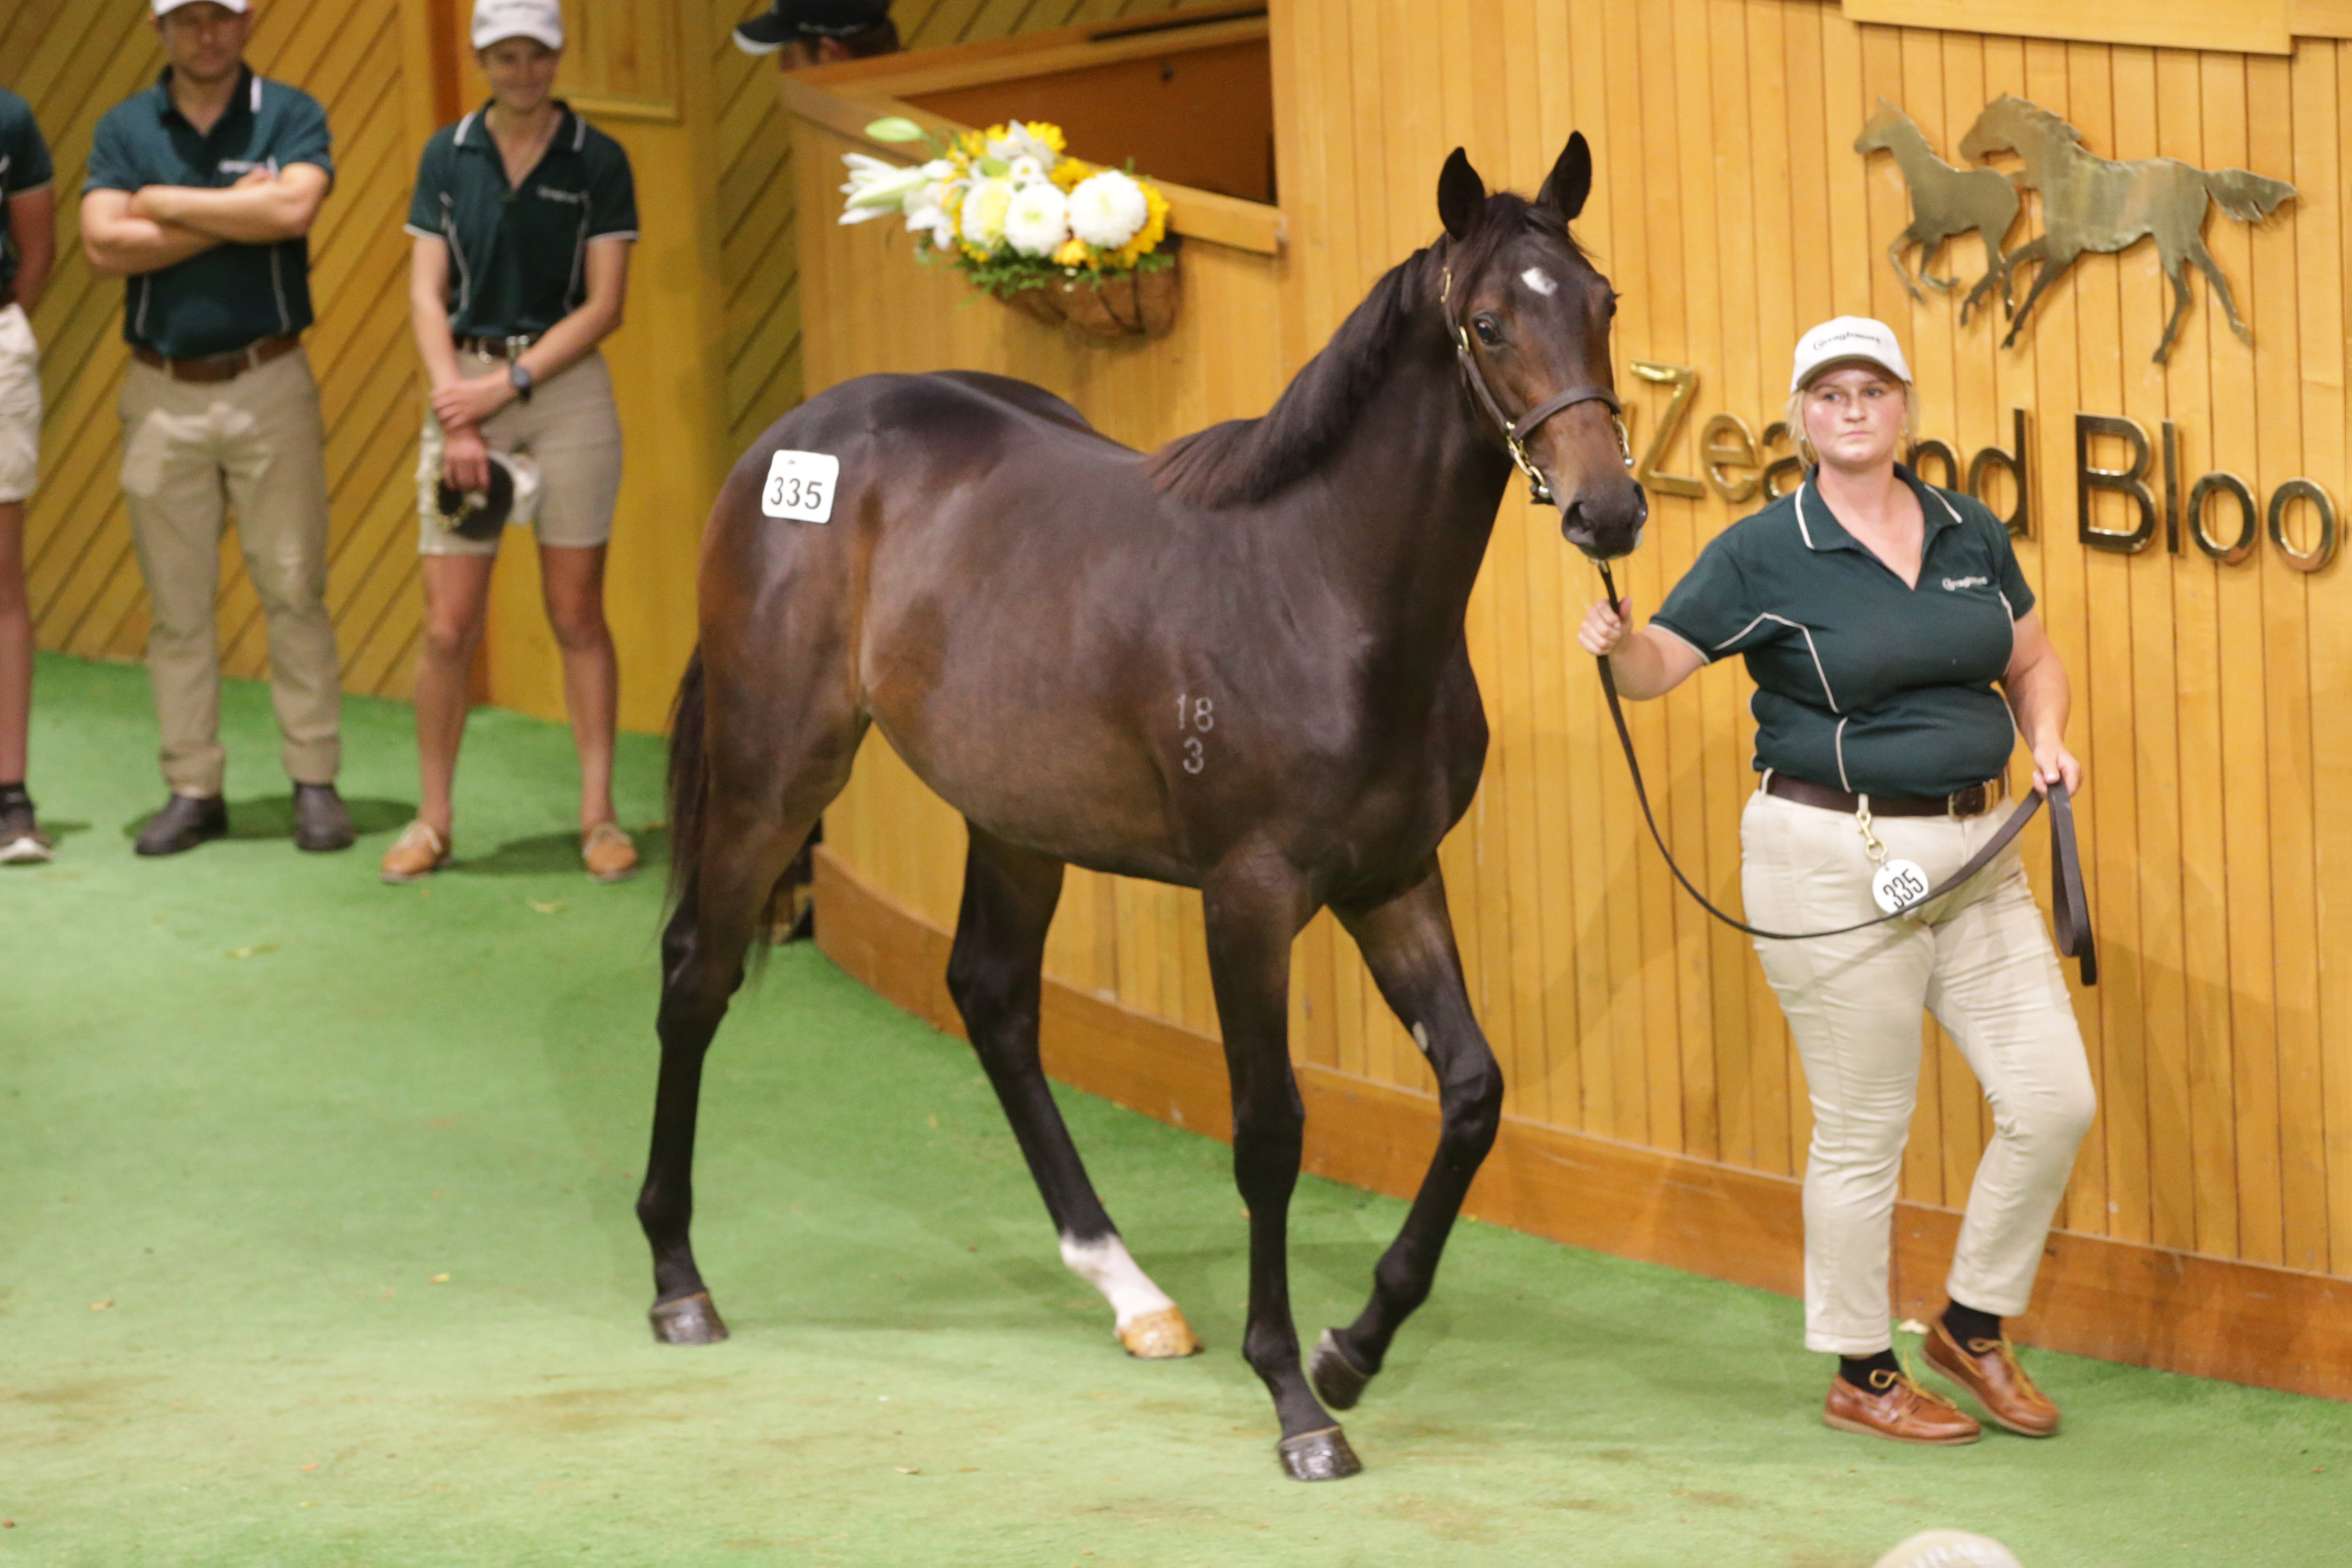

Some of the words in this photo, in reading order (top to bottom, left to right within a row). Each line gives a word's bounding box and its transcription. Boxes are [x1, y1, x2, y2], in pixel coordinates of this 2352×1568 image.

[1629, 359, 2029, 538] Zeand
[770, 476, 822, 510] 335
[1177, 693, 1214, 733] 18
[1183, 736, 1205, 774] 3
[1883, 868, 1924, 908] 335
